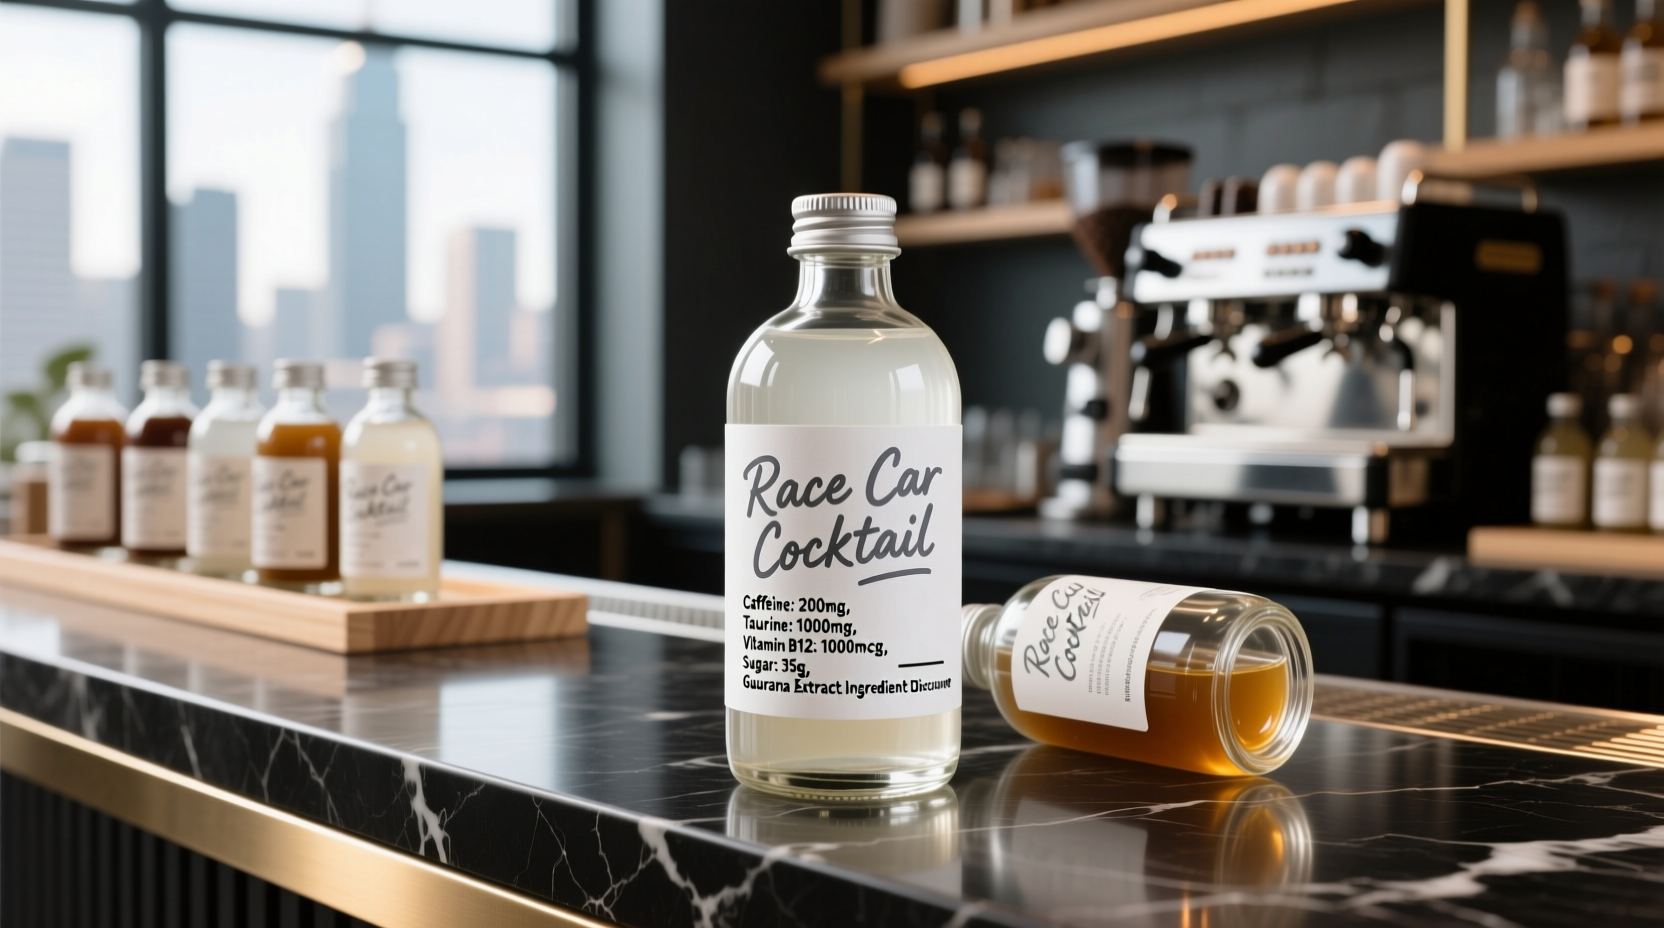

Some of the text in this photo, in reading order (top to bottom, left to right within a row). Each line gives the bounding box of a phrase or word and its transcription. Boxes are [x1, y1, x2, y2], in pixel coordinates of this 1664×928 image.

[743, 446, 943, 518] Race Car
[753, 502, 935, 579] Cocktail
[743, 594, 851, 618] Caffeine: 200mg,
[743, 615, 857, 638] Taurine: 1000mg,
[788, 638, 818, 653] B12:
[820, 638, 888, 657] 1000mcg,
[742, 655, 811, 679] Sugar: 35g,
[845, 679, 908, 699] Ingredient
